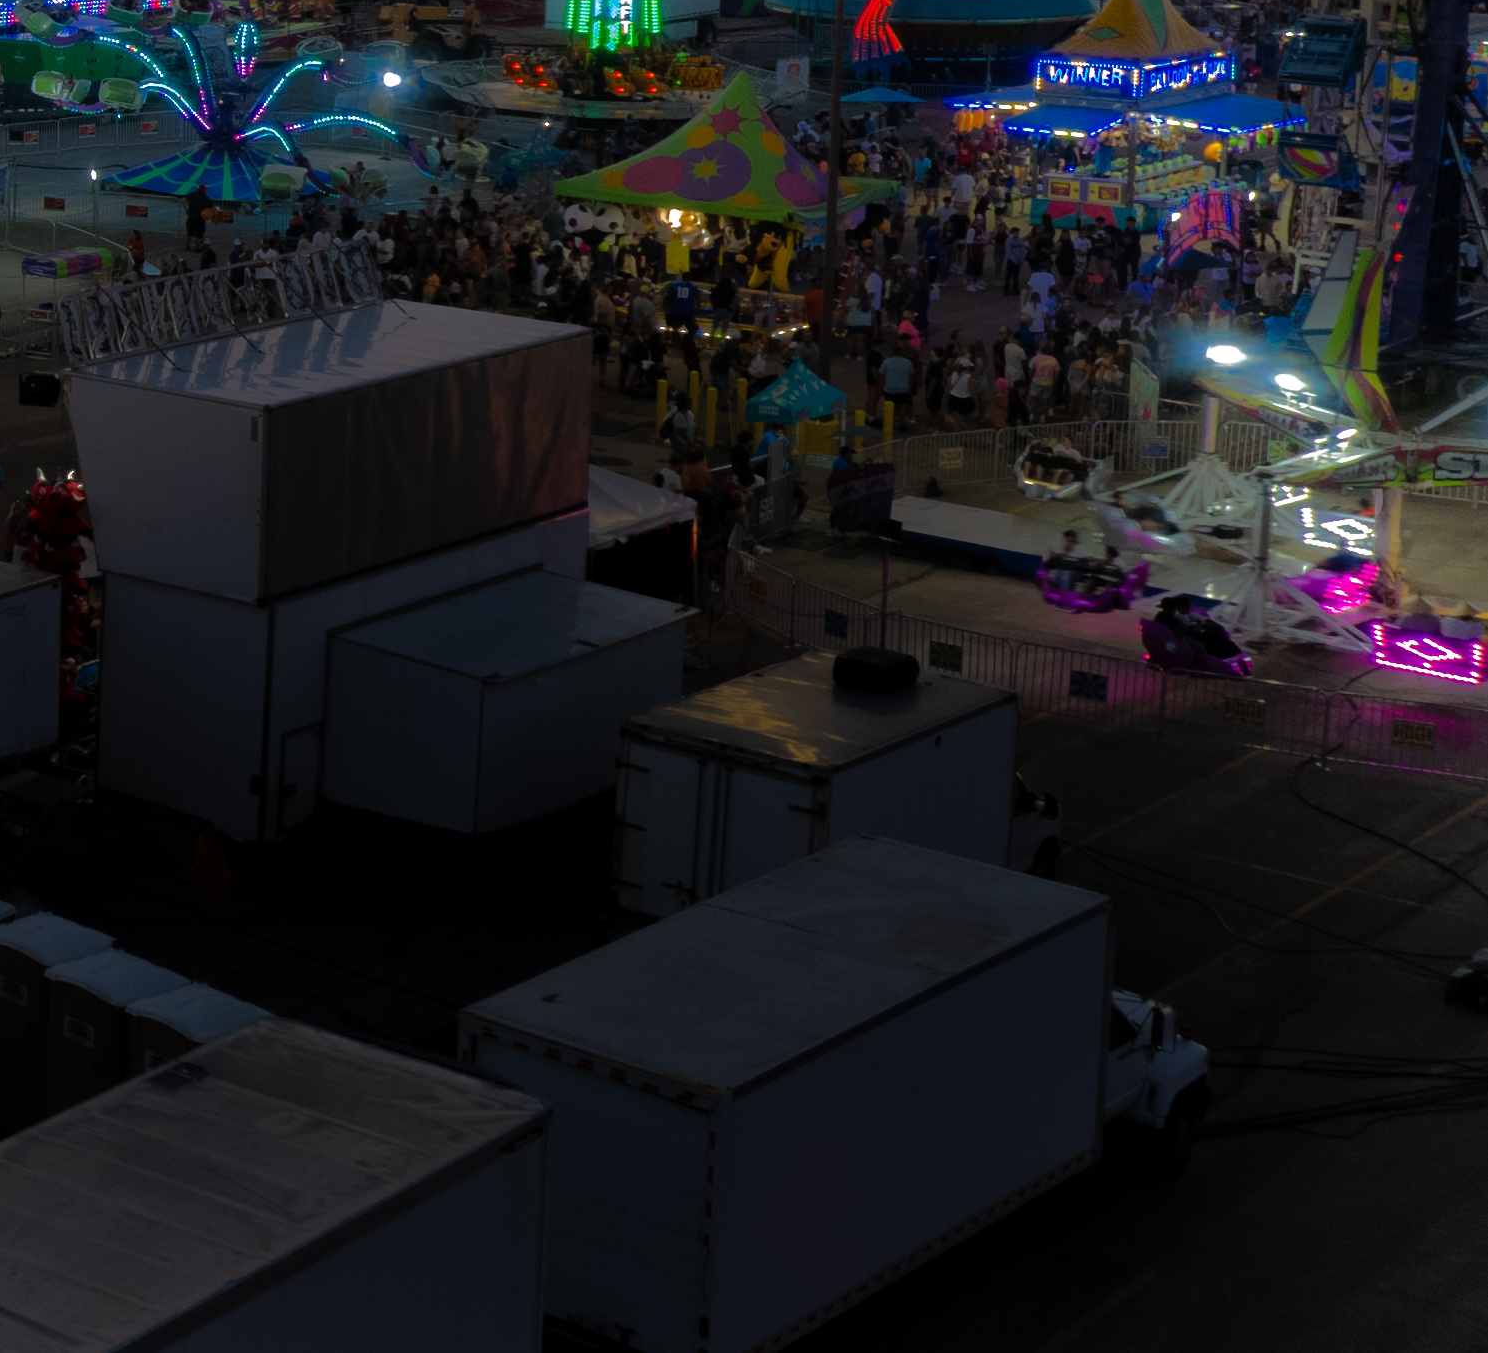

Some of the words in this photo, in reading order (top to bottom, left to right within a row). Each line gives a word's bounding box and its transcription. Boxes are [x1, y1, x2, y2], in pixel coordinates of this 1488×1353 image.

[1048, 65, 1124, 86] WINNER
[676, 286, 690, 298] 10
[1, 977, 22, 998] SOS
